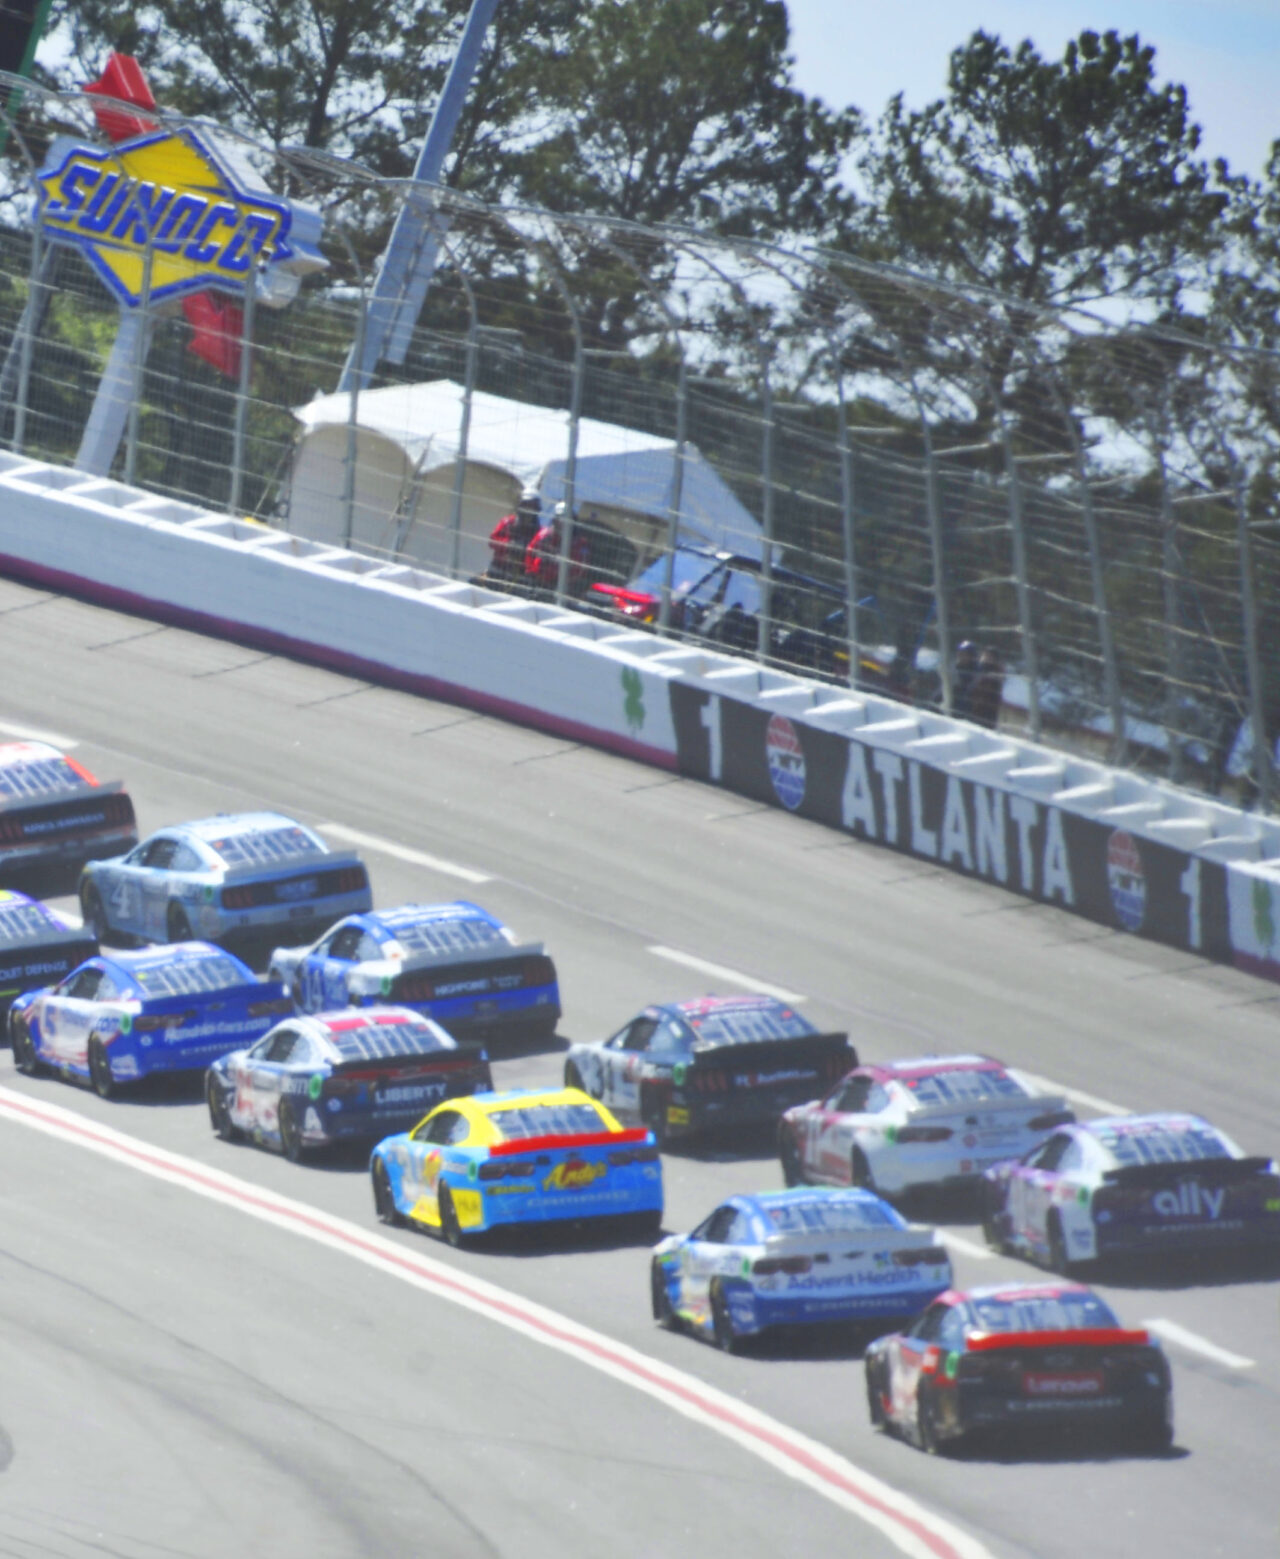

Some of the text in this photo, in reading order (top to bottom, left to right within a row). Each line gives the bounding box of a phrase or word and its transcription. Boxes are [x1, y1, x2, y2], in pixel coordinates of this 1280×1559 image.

[46, 163, 276, 272] SUNOCO
[701, 693, 1203, 949] 1 ATLANTA 1
[24, 960, 68, 977] DEFENSE
[375, 1083, 447, 1104] LIBERTY
[1154, 1181, 1225, 1219] ally
